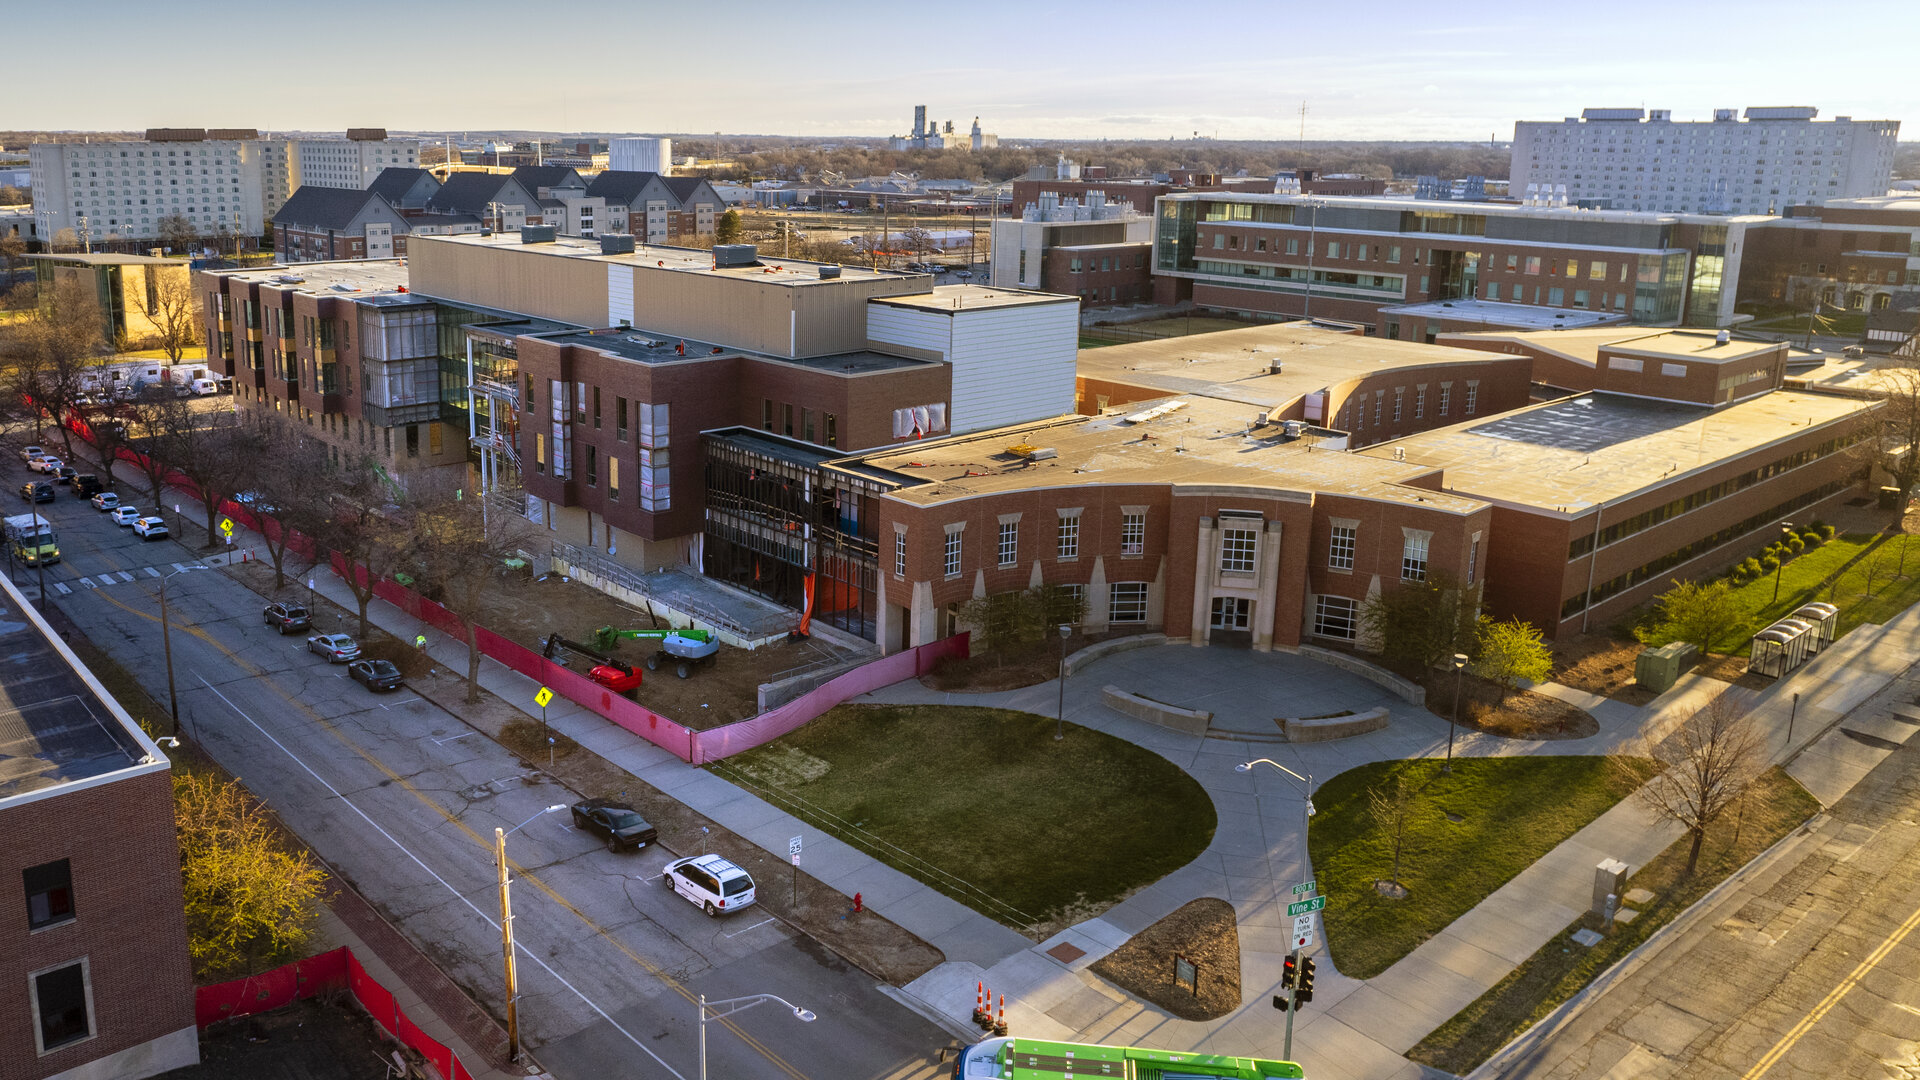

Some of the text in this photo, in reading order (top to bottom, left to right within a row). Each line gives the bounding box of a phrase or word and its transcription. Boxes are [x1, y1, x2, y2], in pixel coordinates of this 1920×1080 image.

[790, 844, 800, 854] 25
[1292, 899, 1320, 914] Vine St
[1299, 916, 1310, 925] NO
